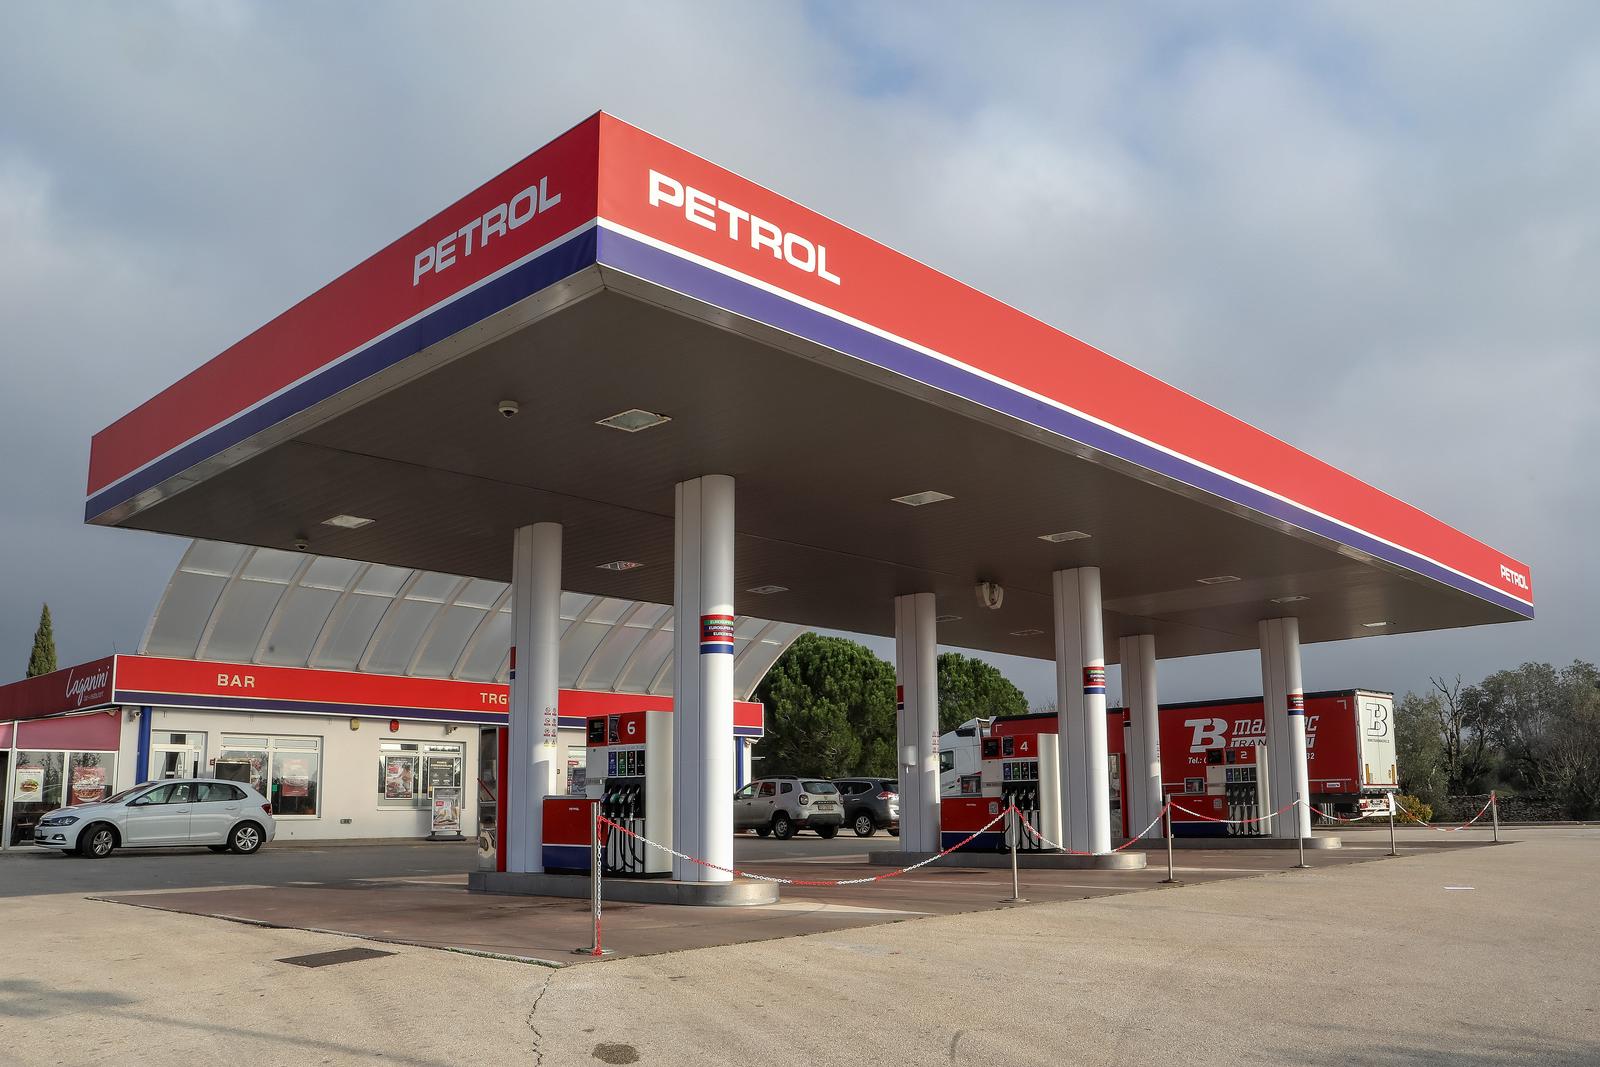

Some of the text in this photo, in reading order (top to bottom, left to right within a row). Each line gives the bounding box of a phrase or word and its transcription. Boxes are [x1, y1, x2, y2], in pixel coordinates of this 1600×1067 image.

[412, 175, 562, 287] PETROL
[648, 168, 842, 286] PETROL
[1500, 564, 1529, 590] PETROL
[66, 666, 109, 706] Laganini
[217, 673, 256, 688] BAR
[480, 692, 510, 705] TRG
[627, 721, 637, 735] 6
[1020, 741, 1029, 752] 4
[1240, 750, 1248, 759] 2
